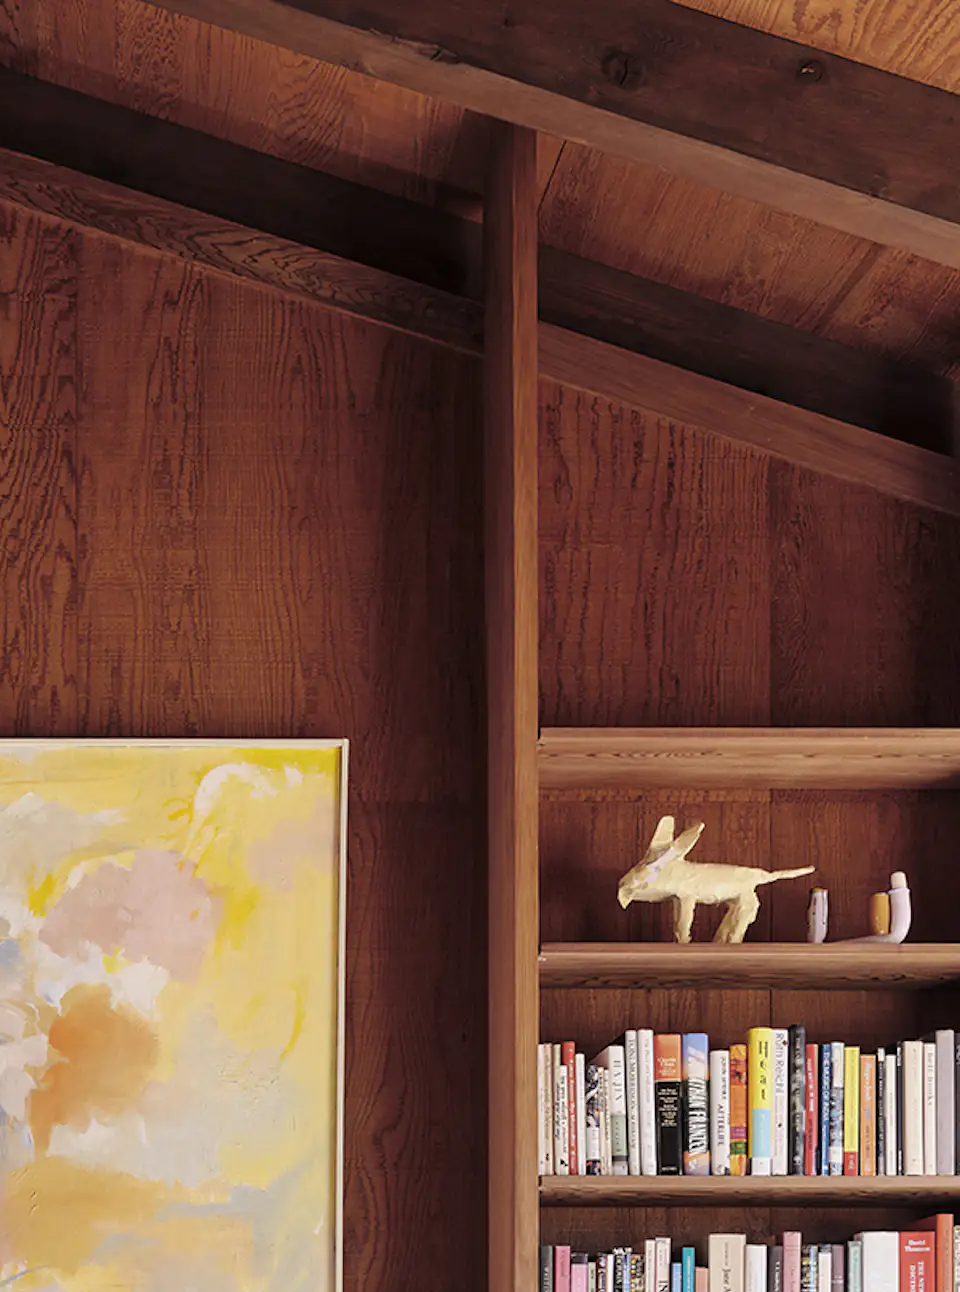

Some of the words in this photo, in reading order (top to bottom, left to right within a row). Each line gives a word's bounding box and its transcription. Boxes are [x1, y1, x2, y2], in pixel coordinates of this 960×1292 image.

[775, 1032, 785, 1058] Ruth
[613, 1059, 623, 1078] HA
[822, 1051, 831, 1066] THE
[775, 1060, 786, 1094] Reichl
[823, 1066, 831, 1090] MUSIC
[613, 1082, 623, 1102] JIN
[823, 1101, 831, 1122] INDIA
[688, 1110, 708, 1156] FRANZEN
[723, 1268, 733, 1285] Jane
[917, 1261, 925, 1276] THE
